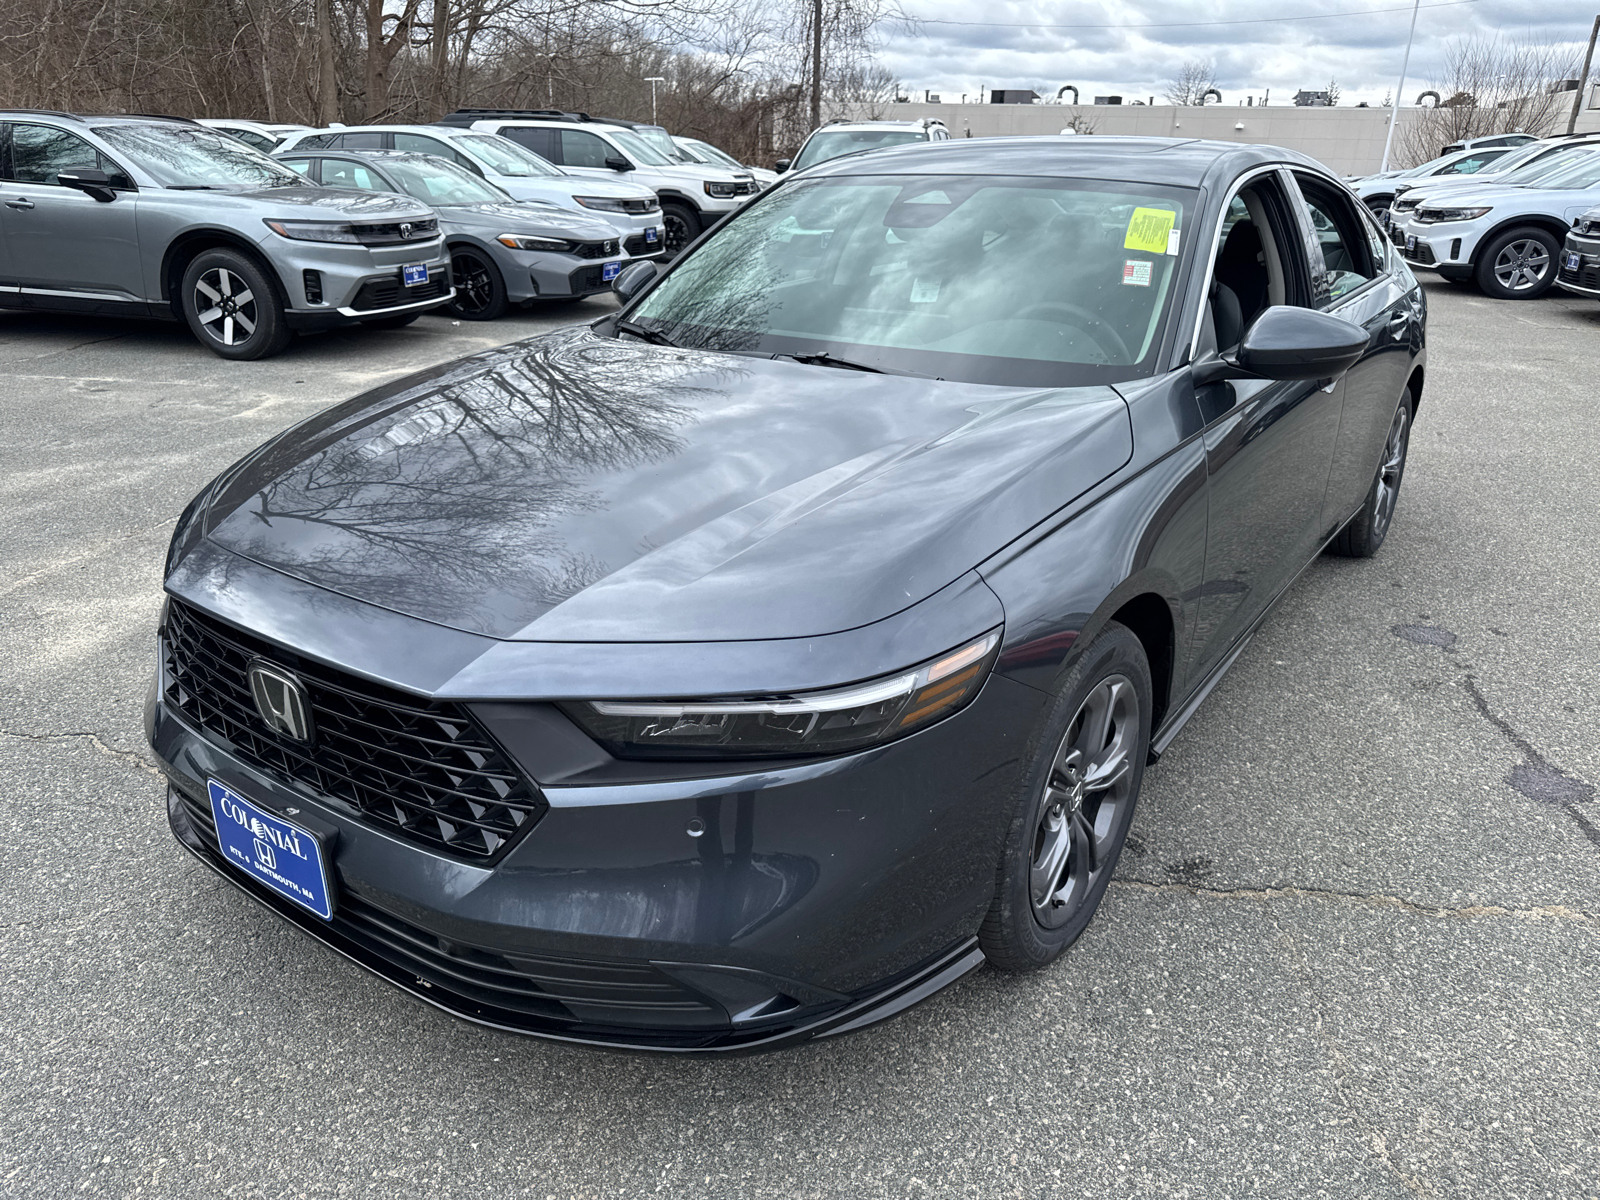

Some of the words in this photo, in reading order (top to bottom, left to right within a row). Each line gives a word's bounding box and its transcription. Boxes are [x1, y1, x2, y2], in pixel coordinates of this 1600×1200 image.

[220, 797, 308, 861] COLONIAL
[254, 860, 302, 895] DARTMOUTH,
[302, 887, 315, 901] MA
